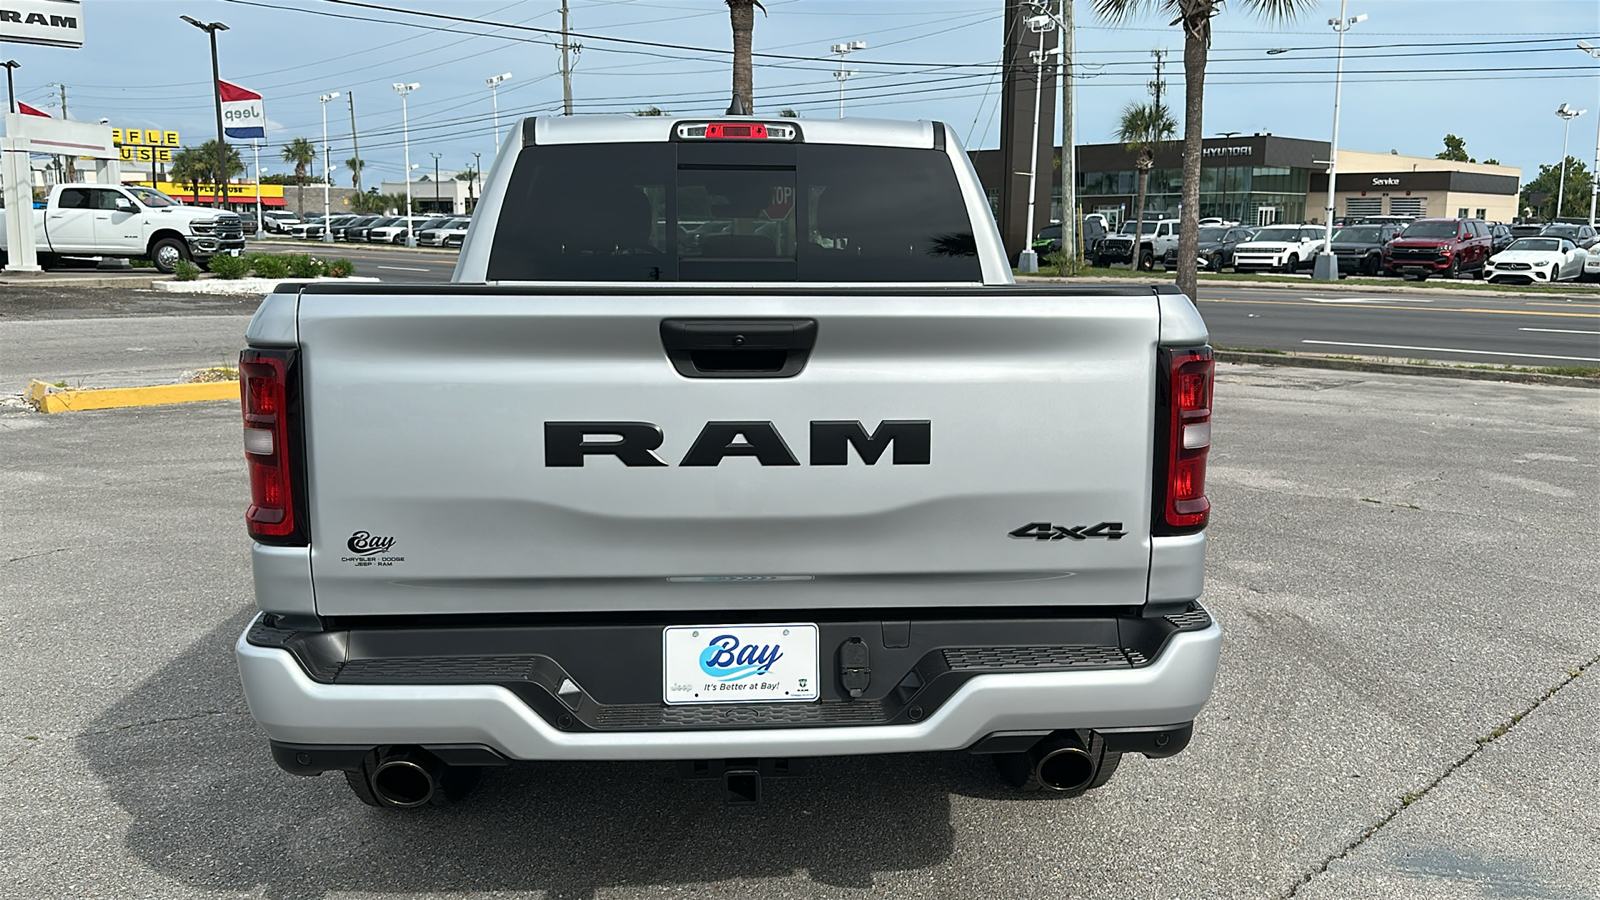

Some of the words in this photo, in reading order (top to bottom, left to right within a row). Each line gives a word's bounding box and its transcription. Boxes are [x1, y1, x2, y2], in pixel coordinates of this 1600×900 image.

[0, 9, 78, 29] RAM
[121, 148, 169, 161] USE
[1371, 177, 1400, 186] Service
[544, 419, 932, 467] RAM
[352, 530, 397, 553] Bay
[706, 634, 784, 676] Bay
[703, 683, 717, 691] It's
[719, 682, 748, 691] Better
[749, 682, 759, 690] at
[760, 681, 780, 691] Bay!
